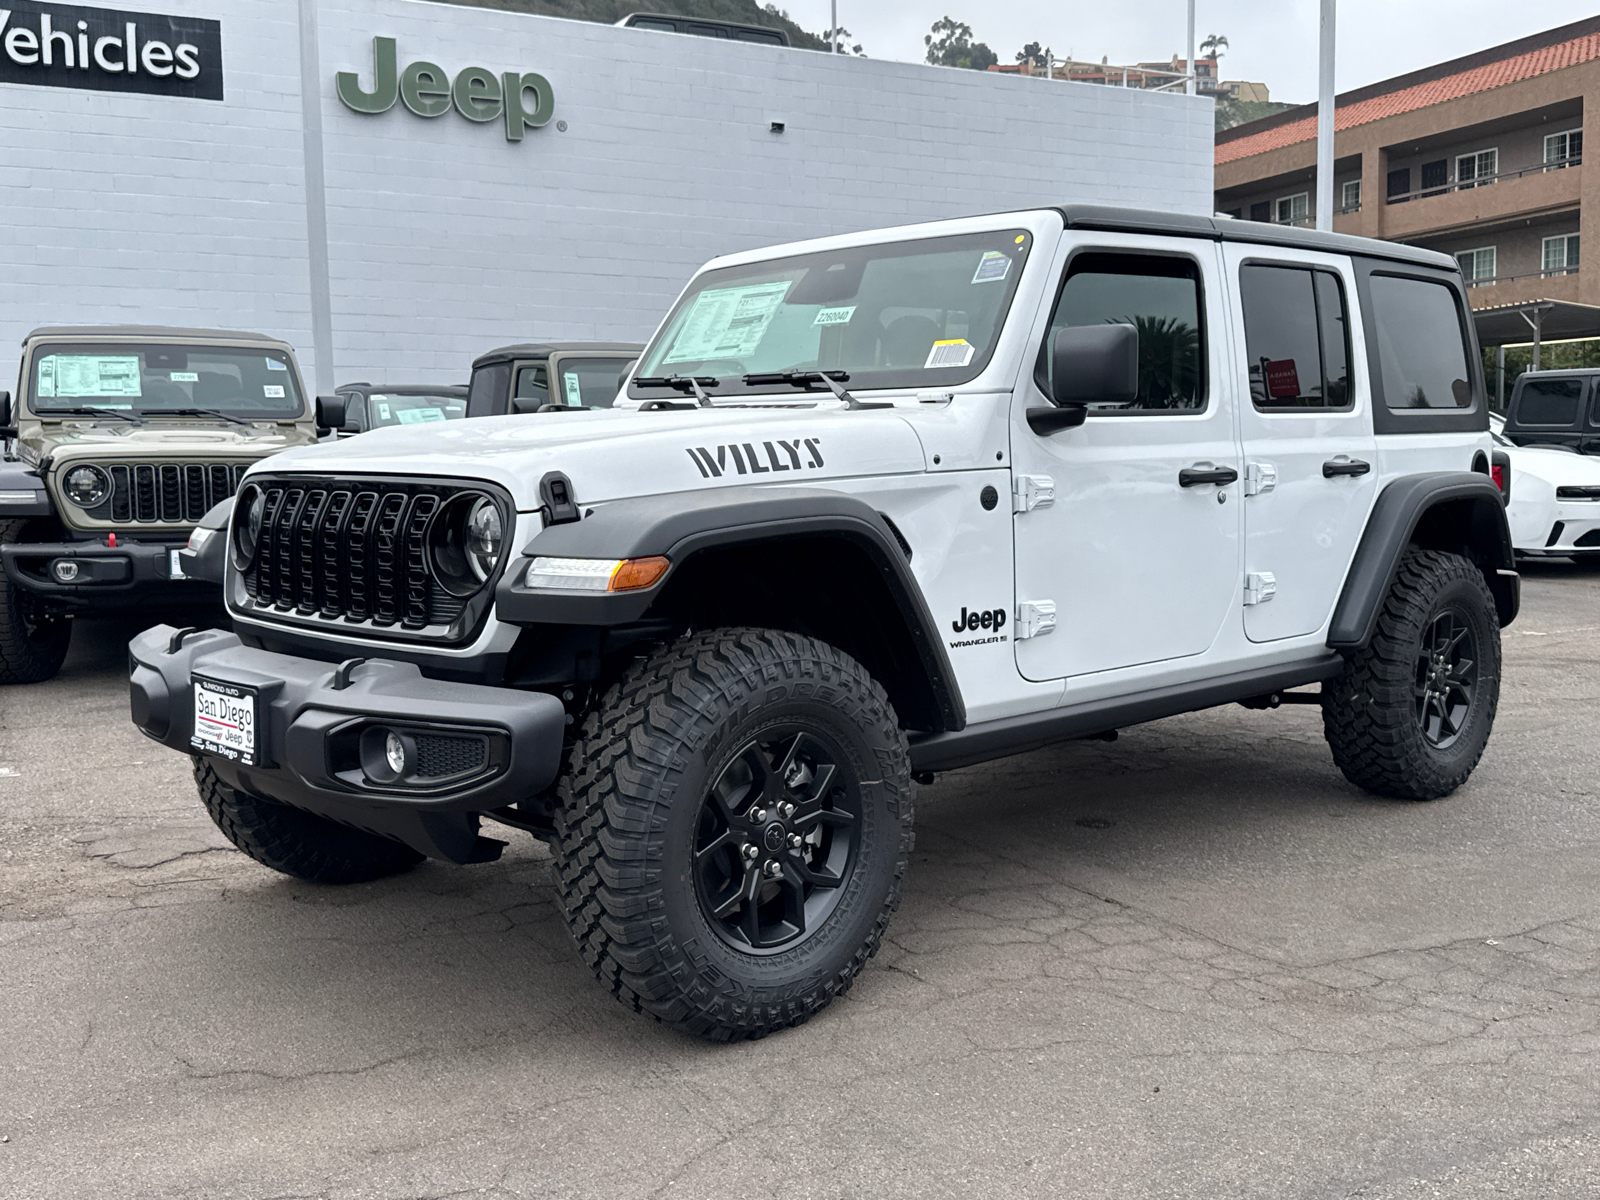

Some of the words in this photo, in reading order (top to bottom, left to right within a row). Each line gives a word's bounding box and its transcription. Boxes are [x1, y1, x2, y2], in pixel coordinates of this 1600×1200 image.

[335, 35, 555, 142] Jeep
[816, 310, 850, 323] 2260040
[685, 438, 824, 478] WILLYS
[952, 606, 1006, 633] Jeep
[950, 637, 998, 648] WRANGLER
[198, 692, 216, 717] San
[219, 697, 252, 731] Diego
[701, 681, 875, 766] WILDPEAK
[205, 740, 217, 752] San
[219, 745, 237, 759] Diego
[225, 729, 243, 745] Jeep
